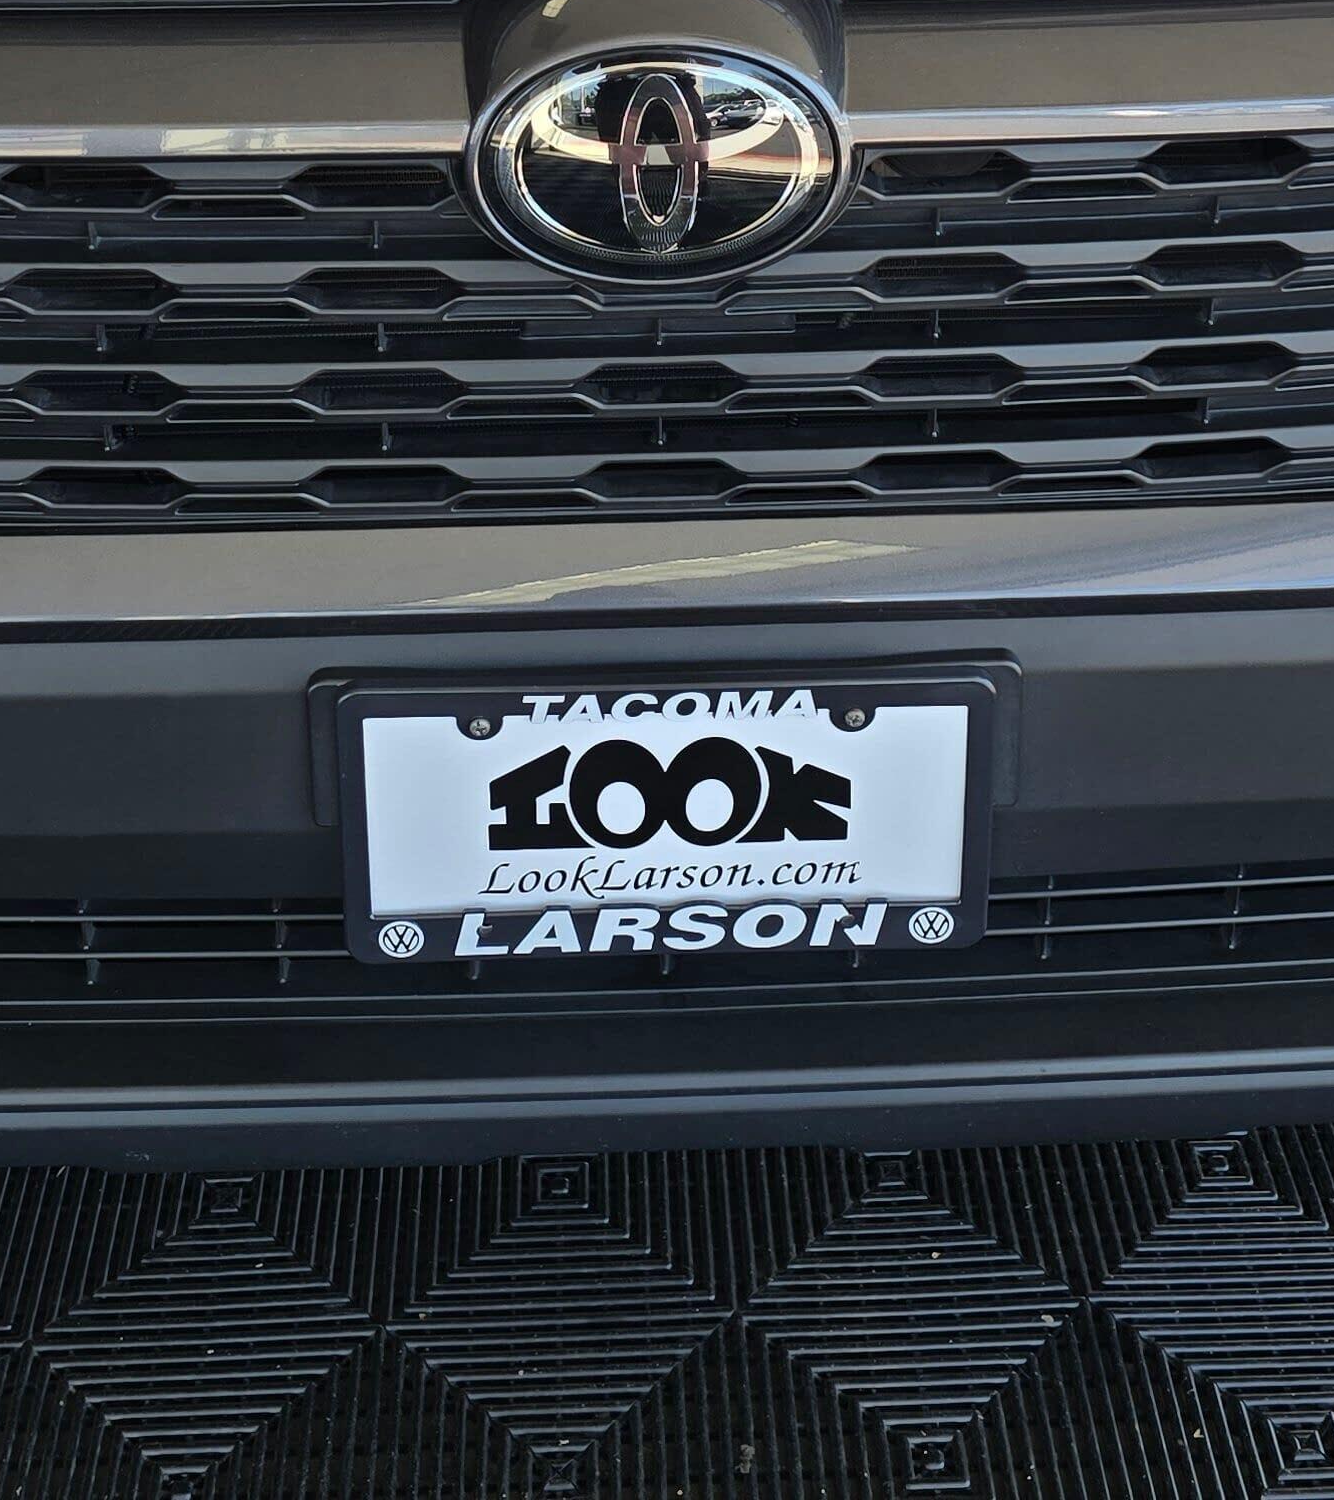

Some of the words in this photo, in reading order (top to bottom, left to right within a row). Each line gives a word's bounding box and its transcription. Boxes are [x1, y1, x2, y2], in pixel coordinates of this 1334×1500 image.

[522, 689, 819, 724] TACOMA
[488, 736, 852, 851] LOOK
[478, 856, 863, 899] LookLarson.com
[455, 902, 888, 956] LARSON
